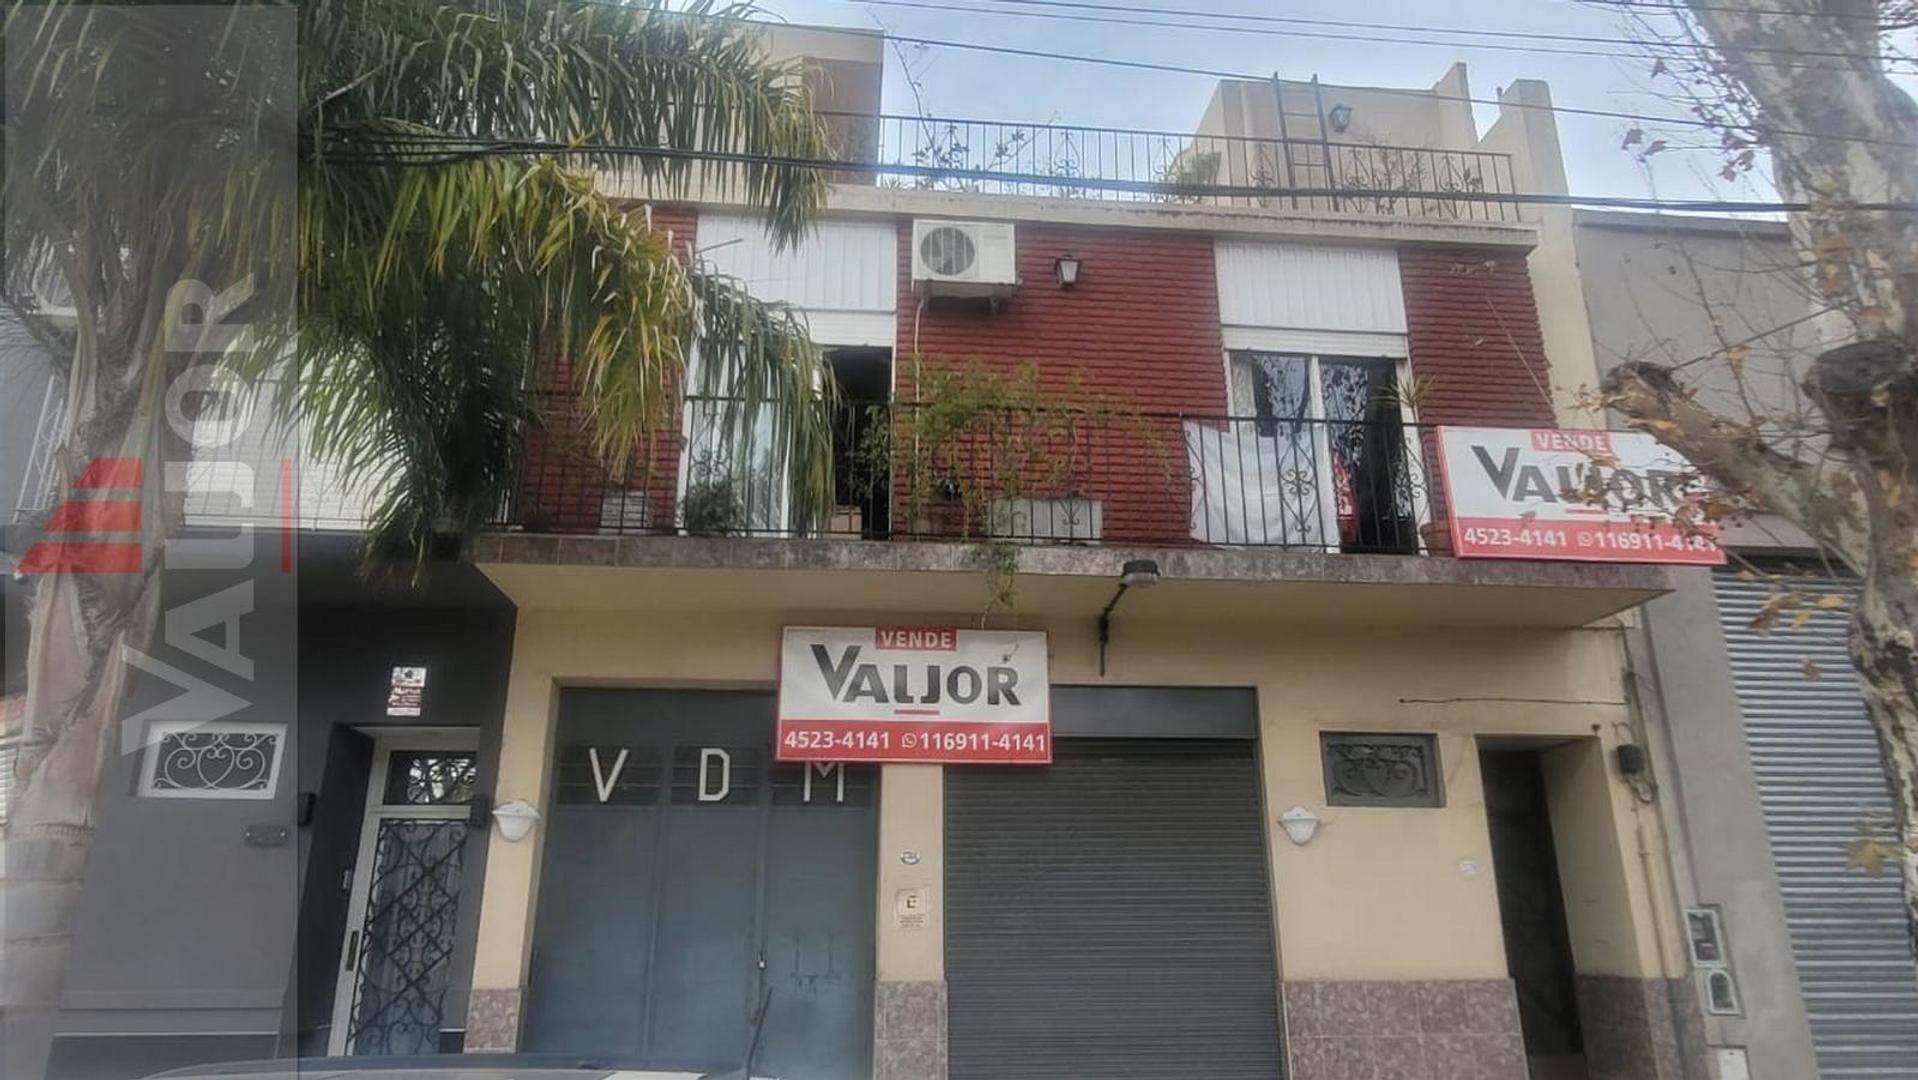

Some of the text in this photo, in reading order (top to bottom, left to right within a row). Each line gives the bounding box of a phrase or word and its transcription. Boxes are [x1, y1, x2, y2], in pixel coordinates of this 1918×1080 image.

[1535, 432, 1607, 451] VENDE
[1471, 445, 1682, 507] VALOR
[1464, 527, 1568, 548] 4523-4141
[881, 631, 952, 649] VENDE
[810, 644, 1022, 706] VALJOR
[784, 730, 1045, 752] 4523-4141 116911-4141
[589, 748, 629, 802] V
[699, 749, 730, 801] D
[906, 895, 917, 909] E
